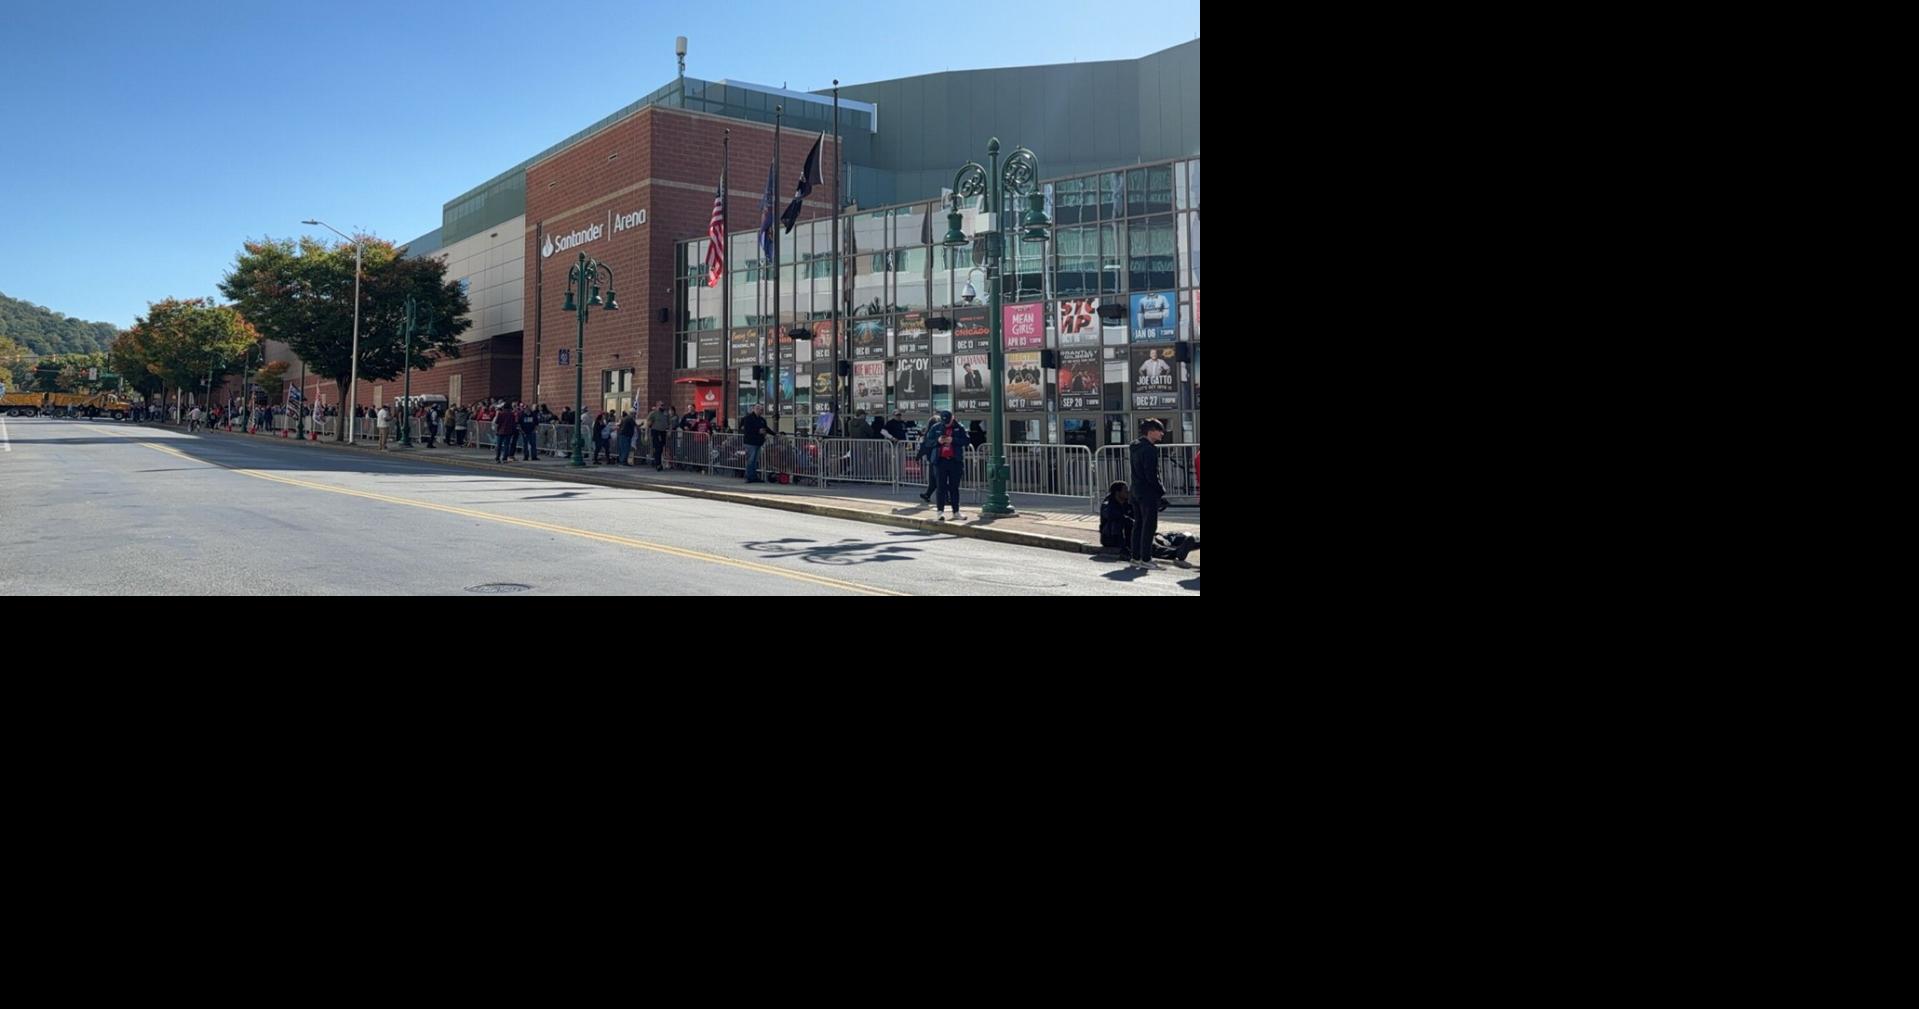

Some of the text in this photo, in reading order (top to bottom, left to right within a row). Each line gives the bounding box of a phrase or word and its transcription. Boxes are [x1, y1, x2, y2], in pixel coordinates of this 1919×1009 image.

[555, 208, 646, 253] Santander Arena
[1012, 312, 1034, 324] MEAN
[955, 327, 991, 337] CHICAGO
[1012, 323, 1035, 335] GIRLS
[1135, 329, 1146, 339] JAN
[958, 341, 967, 350] DEC
[1008, 337, 1018, 346] APR
[1137, 375, 1172, 386] JOE GATTO
[958, 400, 969, 409] NOV
[1008, 399, 1018, 408] OCT
[1063, 397, 1073, 407] SEP
[1137, 396, 1149, 406] DEC
[1150, 396, 1158, 406] 27
